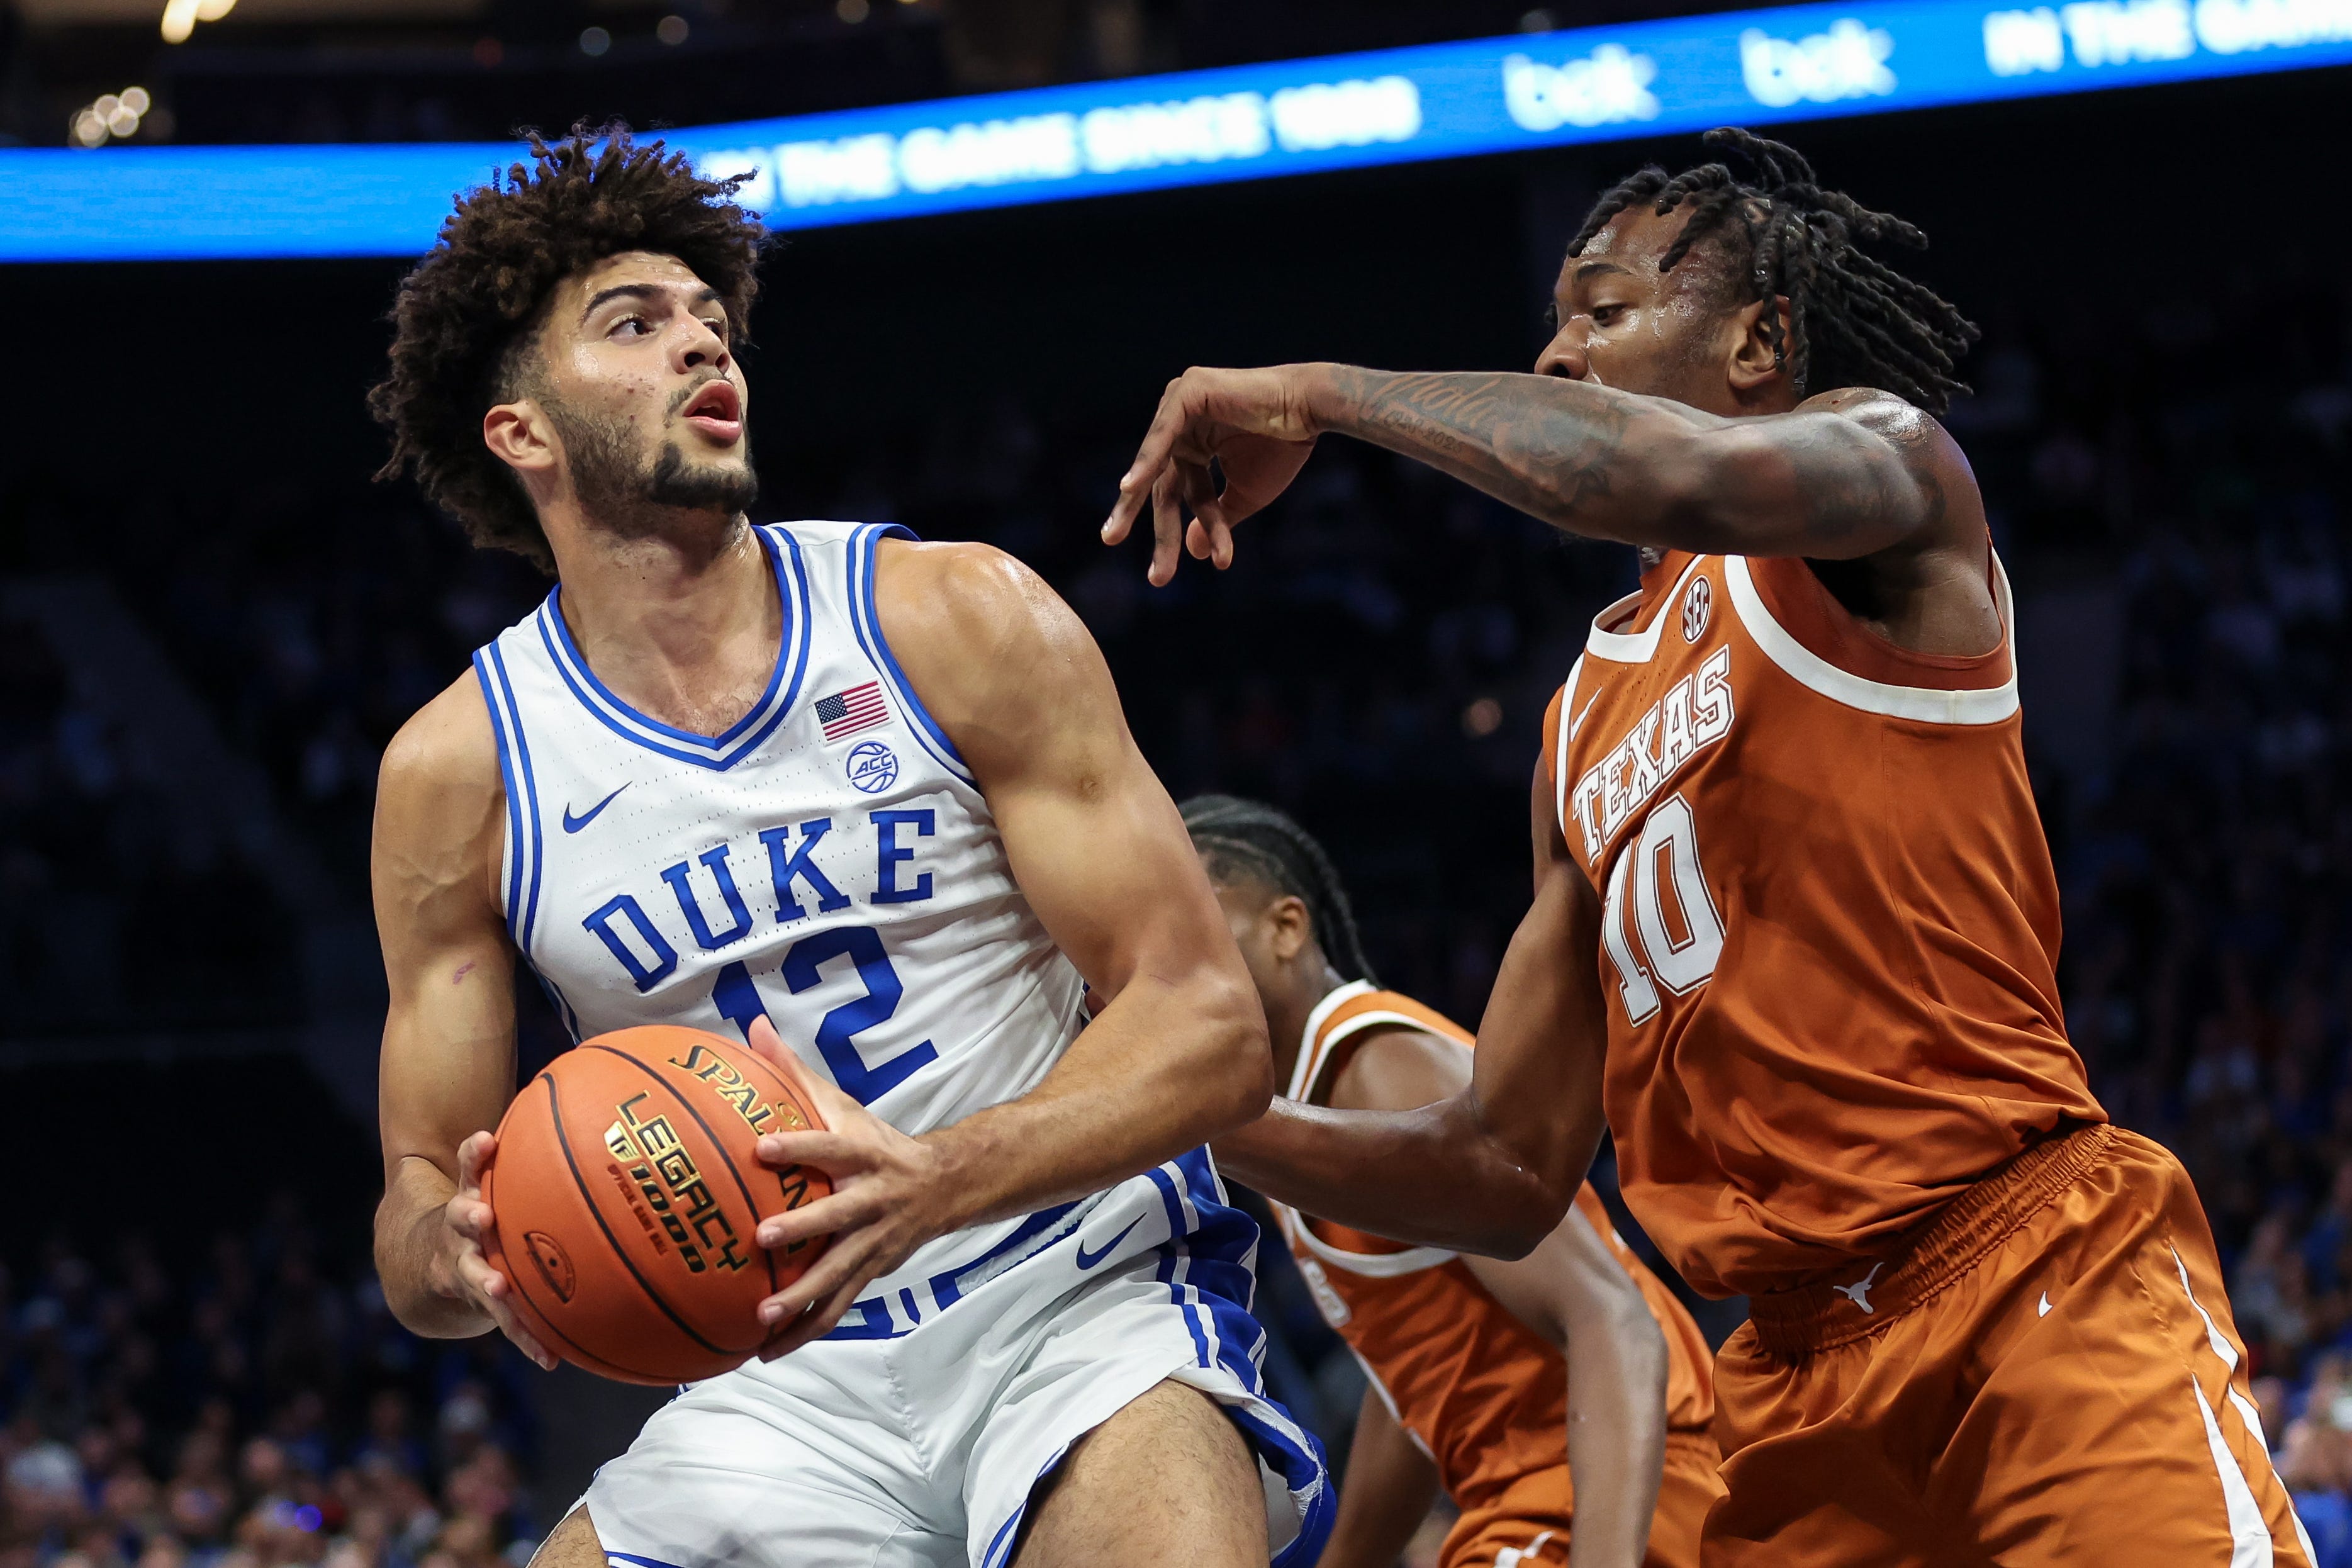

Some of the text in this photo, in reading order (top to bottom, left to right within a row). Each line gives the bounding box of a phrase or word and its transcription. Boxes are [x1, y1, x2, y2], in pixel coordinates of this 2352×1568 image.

[1684, 580, 1709, 639] SEC
[854, 752, 892, 775] ACC
[1571, 644, 1735, 868] TEXAS
[581, 809, 936, 993] DUKE
[1601, 791, 1727, 1029] 10
[712, 926, 939, 1106] 12
[615, 1089, 749, 1272] LEGACY
